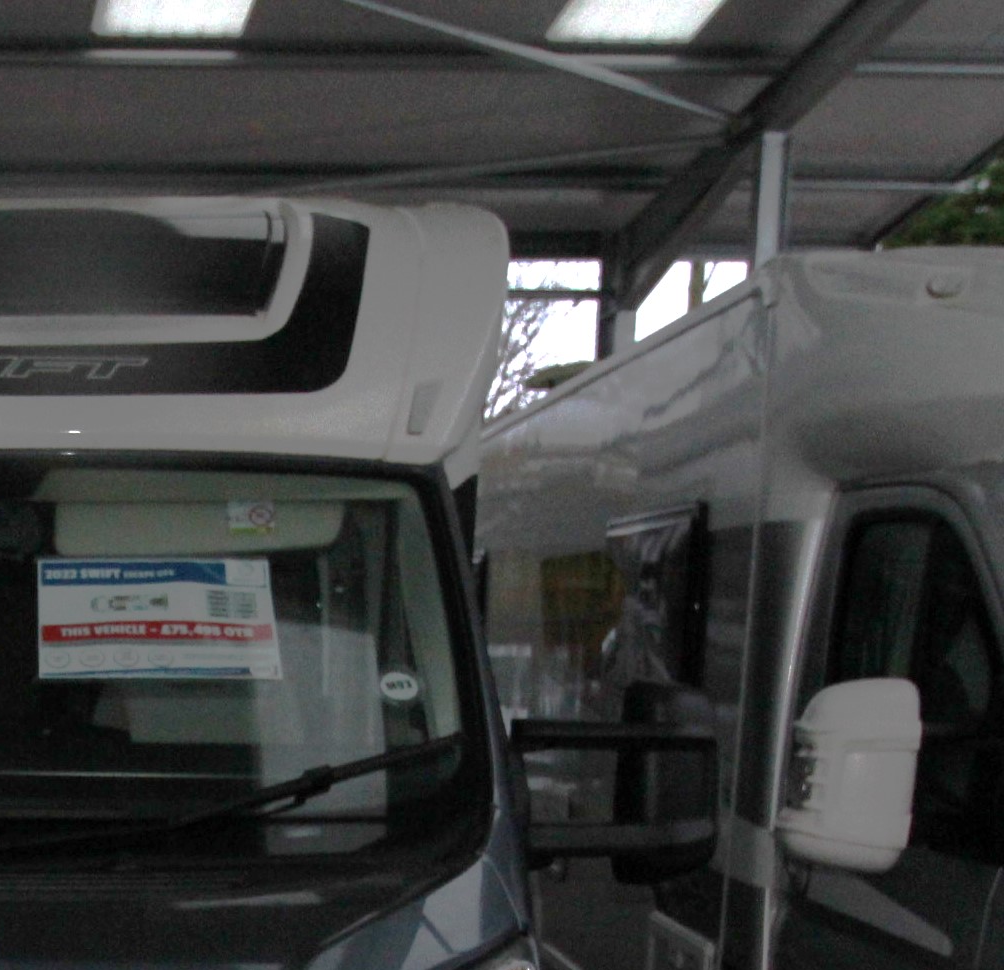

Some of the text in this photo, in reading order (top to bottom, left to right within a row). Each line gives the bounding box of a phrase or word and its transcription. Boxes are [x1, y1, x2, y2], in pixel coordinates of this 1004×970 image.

[80, 568, 121, 580] SWIFT
[60, 626, 91, 637] THIS
[94, 624, 146, 637] VEHICLE
